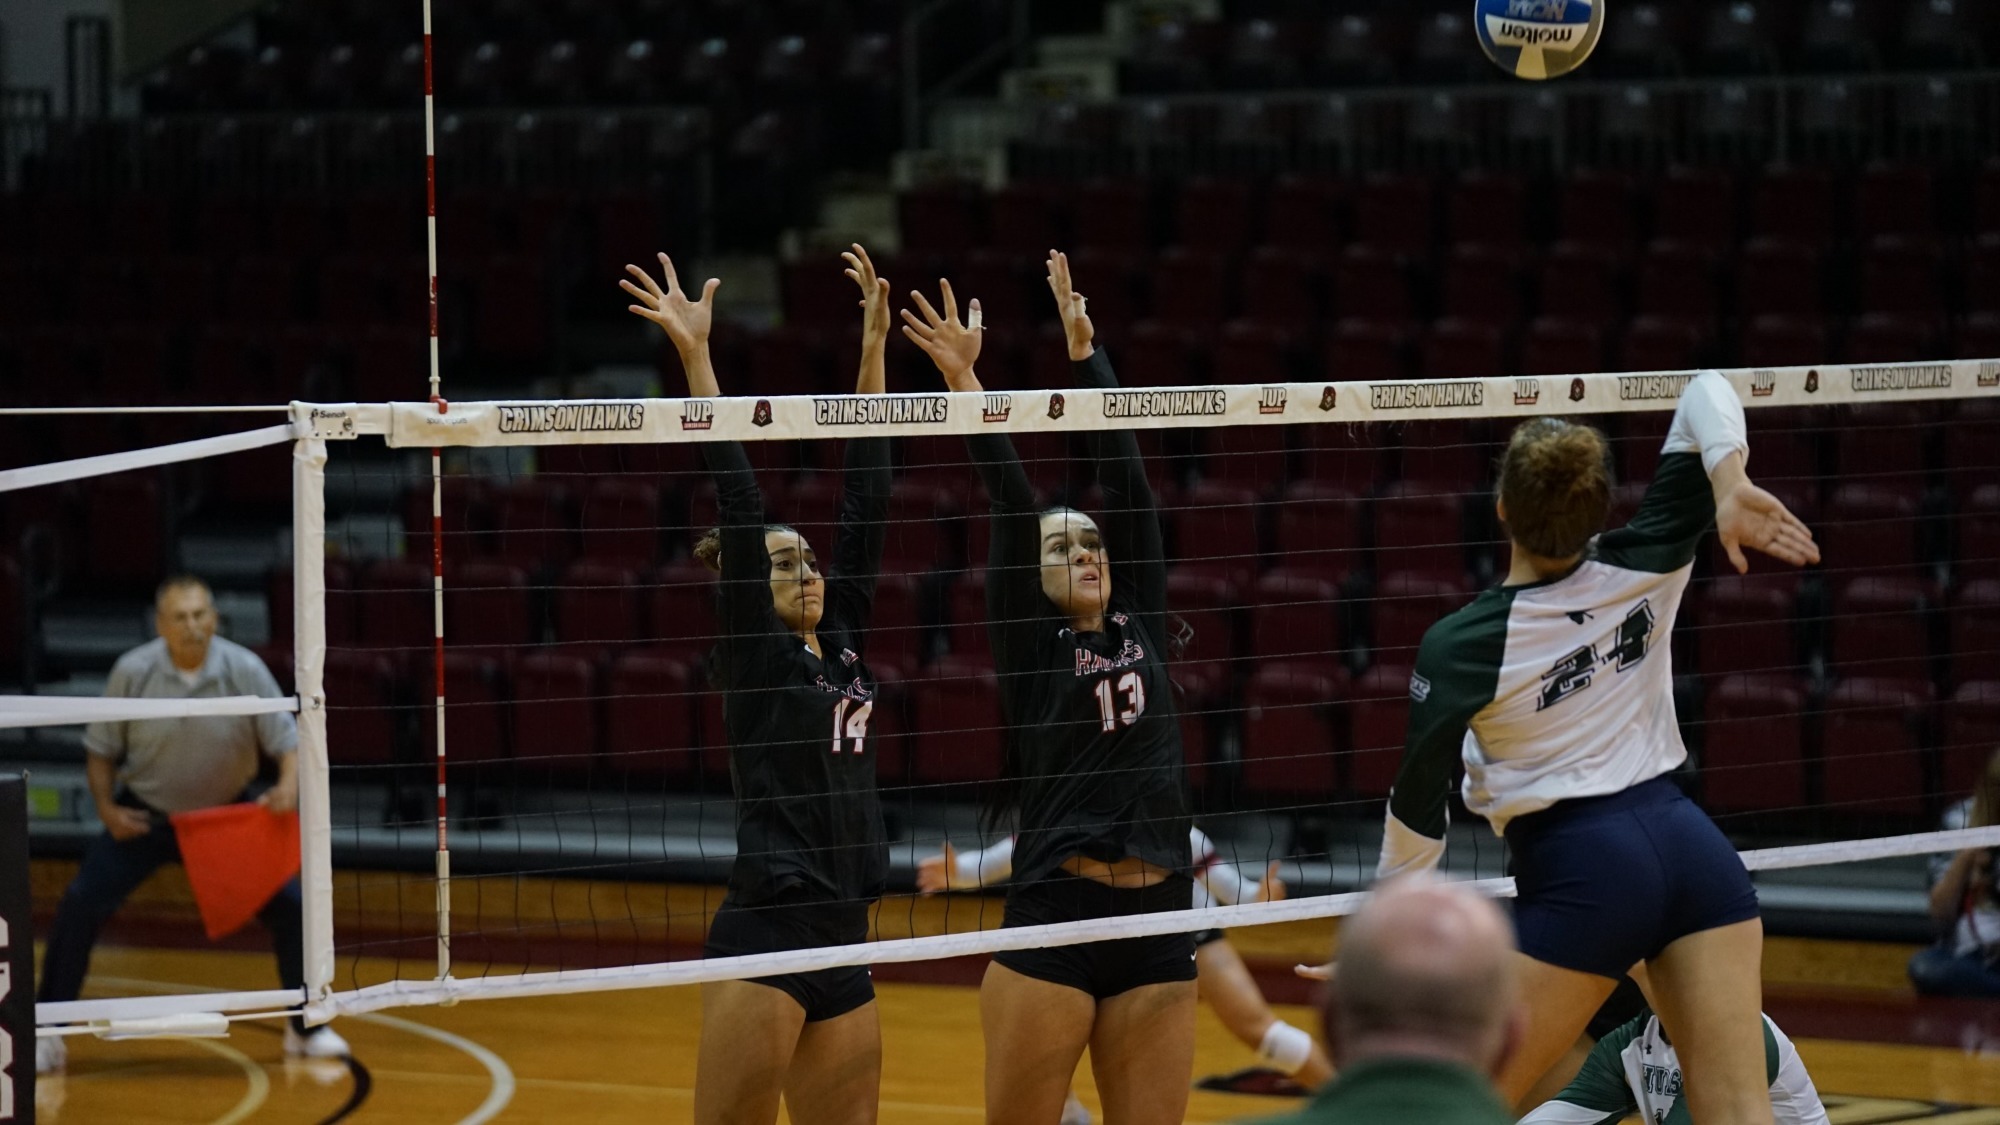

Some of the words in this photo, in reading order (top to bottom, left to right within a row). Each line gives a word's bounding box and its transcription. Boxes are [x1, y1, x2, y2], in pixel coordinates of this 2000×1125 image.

[1501, 22, 1572, 44] molten
[1515, 379, 1540, 398] IUP
[1617, 376, 1677, 400] CRIMSON
[1753, 371, 1776, 389] IUP
[1851, 367, 1903, 391] CRIMSON
[1906, 365, 1951, 389] HAWKS
[984, 394, 1011, 415] IUP
[1102, 392, 1170, 417] CRIMSON
[1172, 390, 1226, 415] HAWKS
[1261, 386, 1287, 406] IUP
[1369, 384, 1431, 409] CRIMSON
[1433, 382, 1483, 407] HAWKS
[498, 405, 577, 432] CRIMSON
[579, 404, 644, 430] HAWKS
[684, 400, 713, 422] IUP
[813, 399, 886, 425] CRIMSON
[889, 397, 947, 423] HAWKS
[1095, 671, 1145, 734] 13
[832, 697, 873, 753] 14
